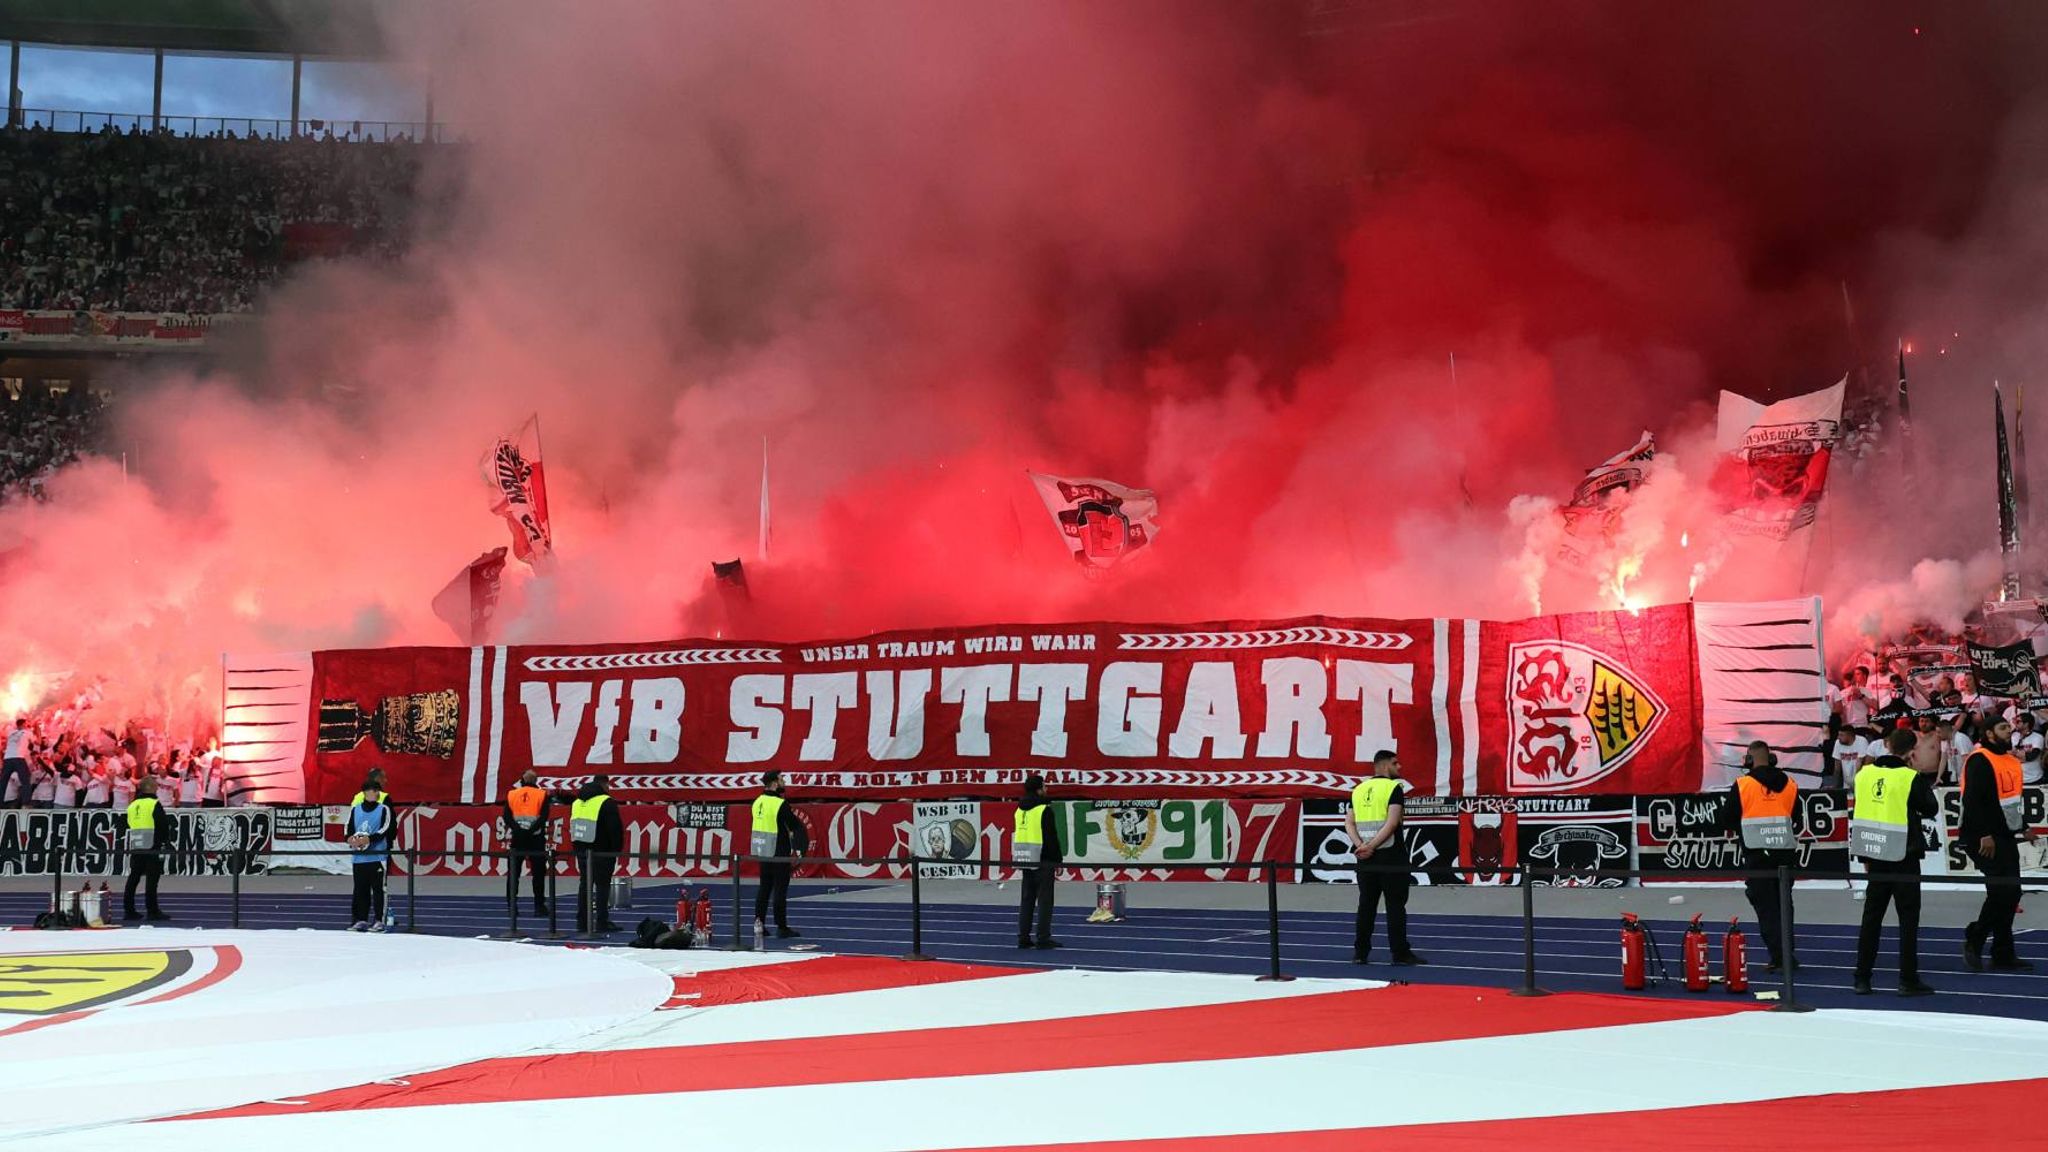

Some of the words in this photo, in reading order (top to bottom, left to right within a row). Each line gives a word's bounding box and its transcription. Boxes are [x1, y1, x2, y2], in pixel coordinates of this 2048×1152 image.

[801, 643, 870, 663] UNSER
[877, 641, 955, 658] TRAUM
[964, 635, 1023, 653] WIRD
[1030, 634, 1097, 651] WAHR
[1982, 659, 2009, 669] COPS
[1574, 676, 1586, 694] 93
[520, 677, 686, 767] VfB
[725, 657, 1414, 763] STUTTGART
[1581, 735, 1592, 750] 18
[790, 773, 843, 786] WIR
[853, 772, 929, 786] HOL'N
[939, 770, 986, 783] DEN
[996, 770, 1083, 784] POKAL!
[917, 806, 949, 818] WSB
[954, 803, 975, 815] '81
[1517, 799, 1591, 812] STUTTGART
[1760, 827, 1787, 835] ORDNER
[1861, 831, 1887, 844] ORDNER
[1663, 838, 1817, 868] STUTTT
[920, 864, 976, 878] CESENA
